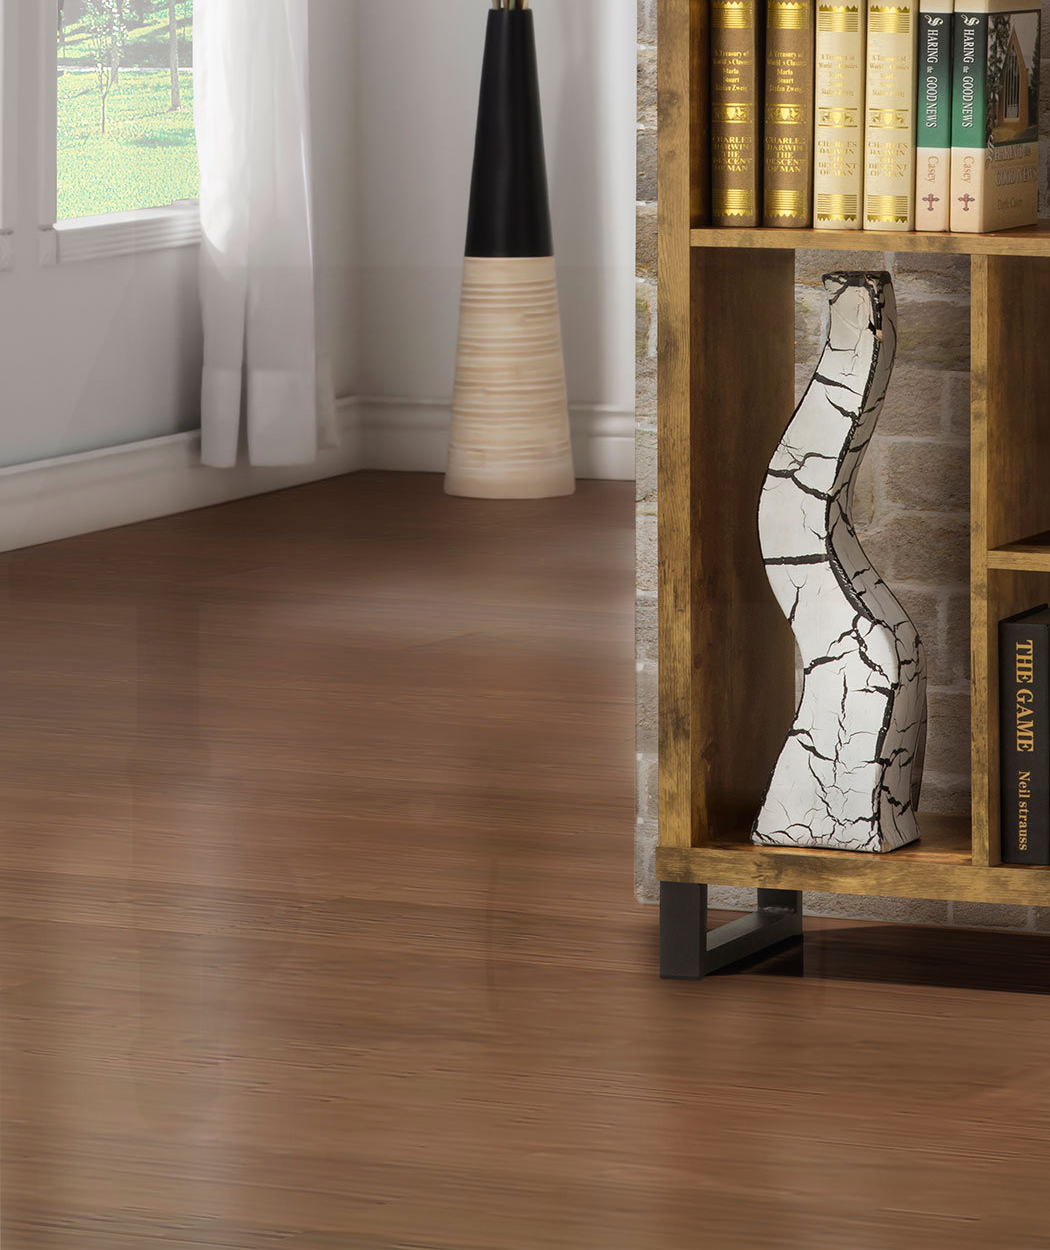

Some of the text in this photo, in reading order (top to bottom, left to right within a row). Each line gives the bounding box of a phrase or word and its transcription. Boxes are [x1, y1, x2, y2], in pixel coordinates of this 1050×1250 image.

[926, 76, 938, 102] GOOD
[962, 76, 974, 102] GOOD
[926, 103, 938, 129] NEWS
[962, 103, 973, 129] NEWS
[926, 156, 939, 184] Casey
[962, 156, 976, 184] Casey
[1016, 639, 1034, 752] THE GAME
[1018, 770, 1030, 851] Neil strauss
